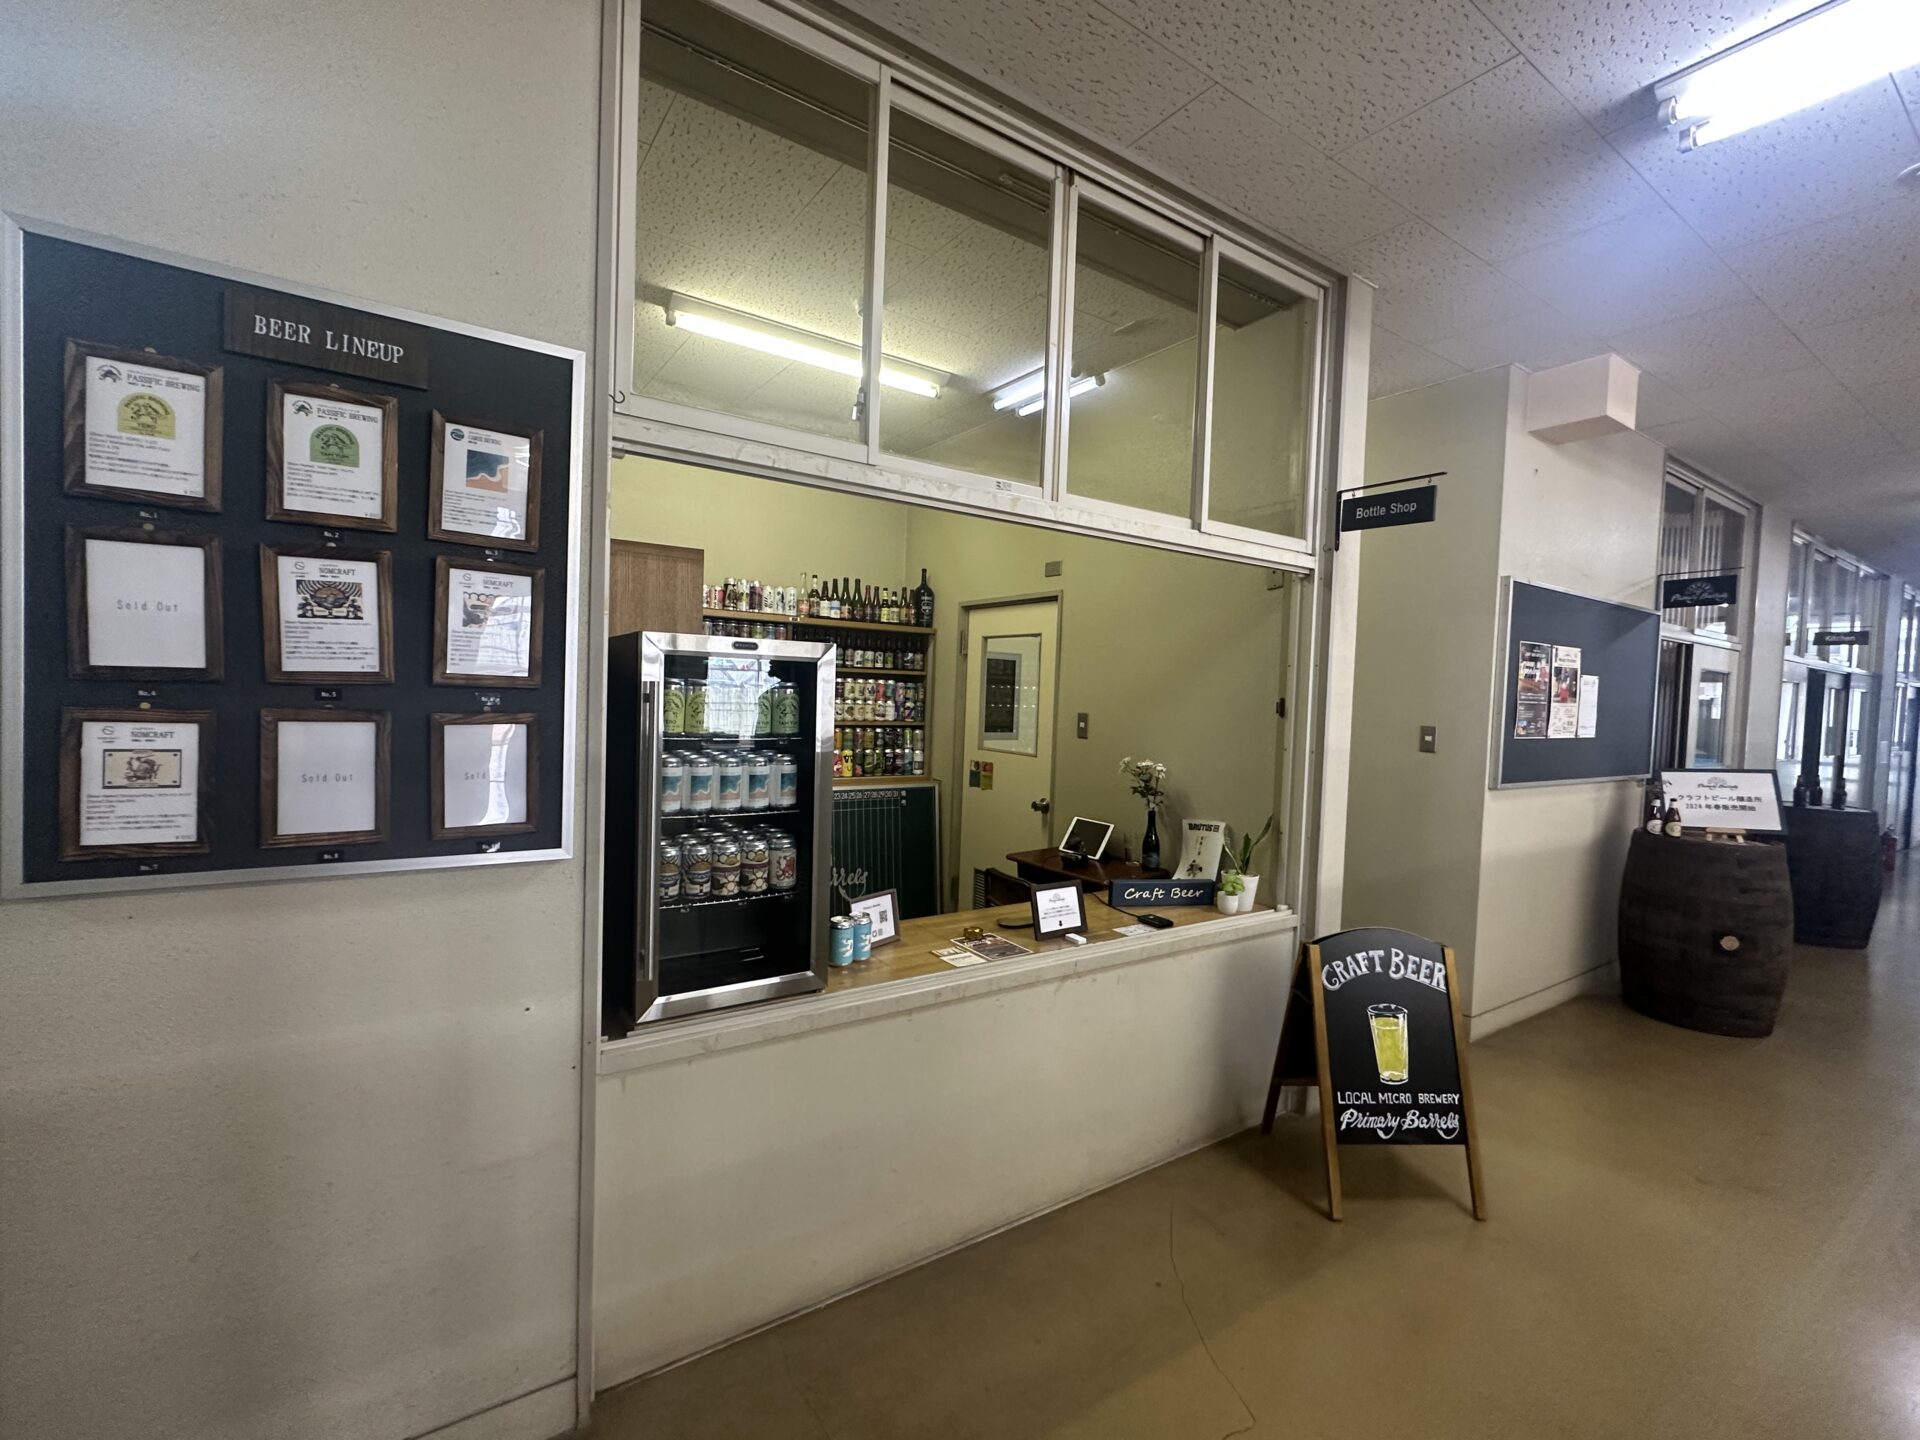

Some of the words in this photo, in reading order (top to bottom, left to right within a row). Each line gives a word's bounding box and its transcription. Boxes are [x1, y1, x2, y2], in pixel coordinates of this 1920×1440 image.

[254, 314, 311, 344] BEER
[325, 330, 404, 363] LINEUP
[126, 373, 163, 387] PASSIFIC
[165, 379, 201, 393] BREWING
[316, 407, 346, 419] PASSIFIC
[349, 412, 378, 424] BREWING
[1355, 505, 1386, 519] Bottle
[1389, 502, 1417, 515] Shop
[117, 599, 147, 611] Sold
[156, 601, 178, 612] Out
[301, 773, 328, 783] Sold
[335, 773, 354, 782] Out
[831, 867, 869, 900] rrels
[1124, 887, 1165, 901] Craft
[1170, 887, 1204, 899] Beer
[1321, 950, 1385, 991] CRAFT
[1388, 947, 1446, 993] BEER
[1337, 1091, 1376, 1104] LOCAL
[1378, 1092, 1412, 1104] MICRO
[1418, 1093, 1460, 1105] BREWERY
[1340, 1108, 1400, 1139] Primary
[1400, 1109, 1460, 1139] Barrels
